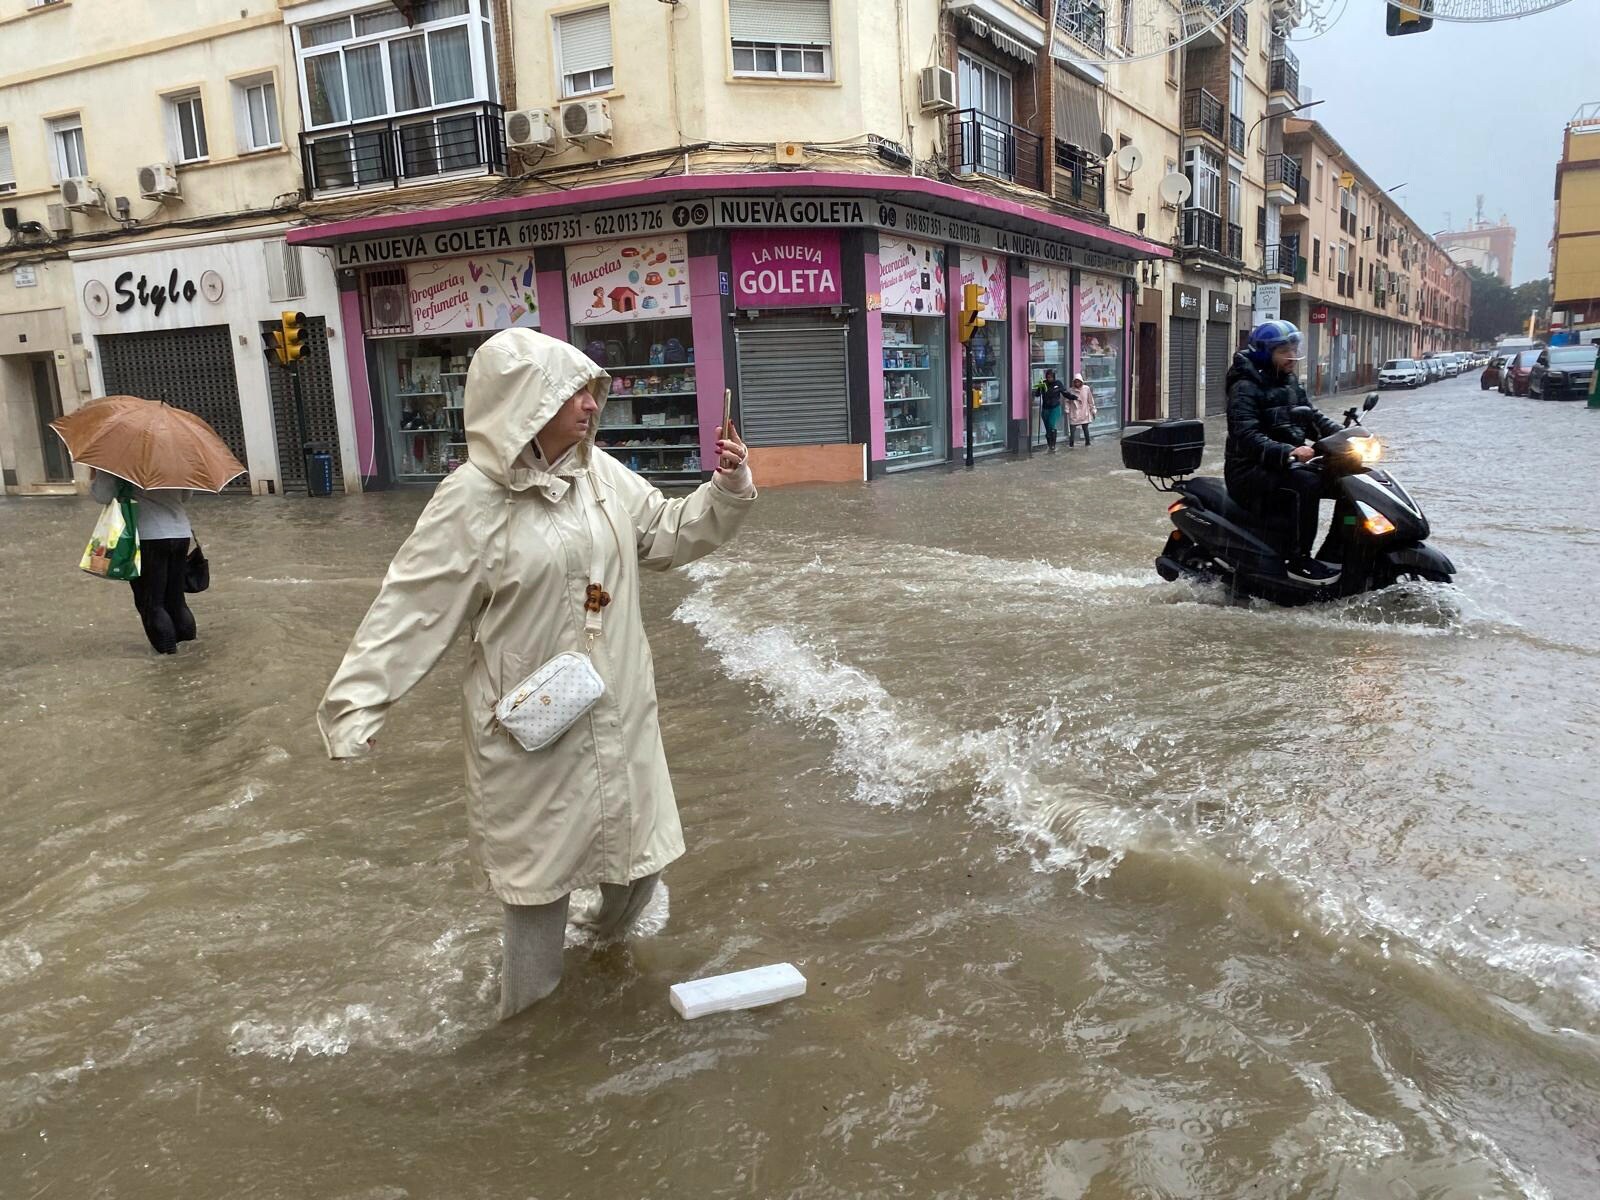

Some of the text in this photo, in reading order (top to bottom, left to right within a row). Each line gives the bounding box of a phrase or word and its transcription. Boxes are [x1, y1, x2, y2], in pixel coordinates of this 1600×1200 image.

[720, 201, 864, 223] NUEVA GOLETA
[338, 244, 361, 265] LA
[364, 237, 428, 262] NUEVA
[434, 226, 512, 254] GOLETA
[751, 245, 822, 265] LA NUEVA
[996, 231, 1009, 252] LA
[1012, 234, 1041, 258] NUEVA
[1043, 242, 1073, 263] GOLETA
[570, 258, 622, 288] Mascotas
[739, 269, 836, 294] GOLETA
[114, 268, 198, 317] Stylo
